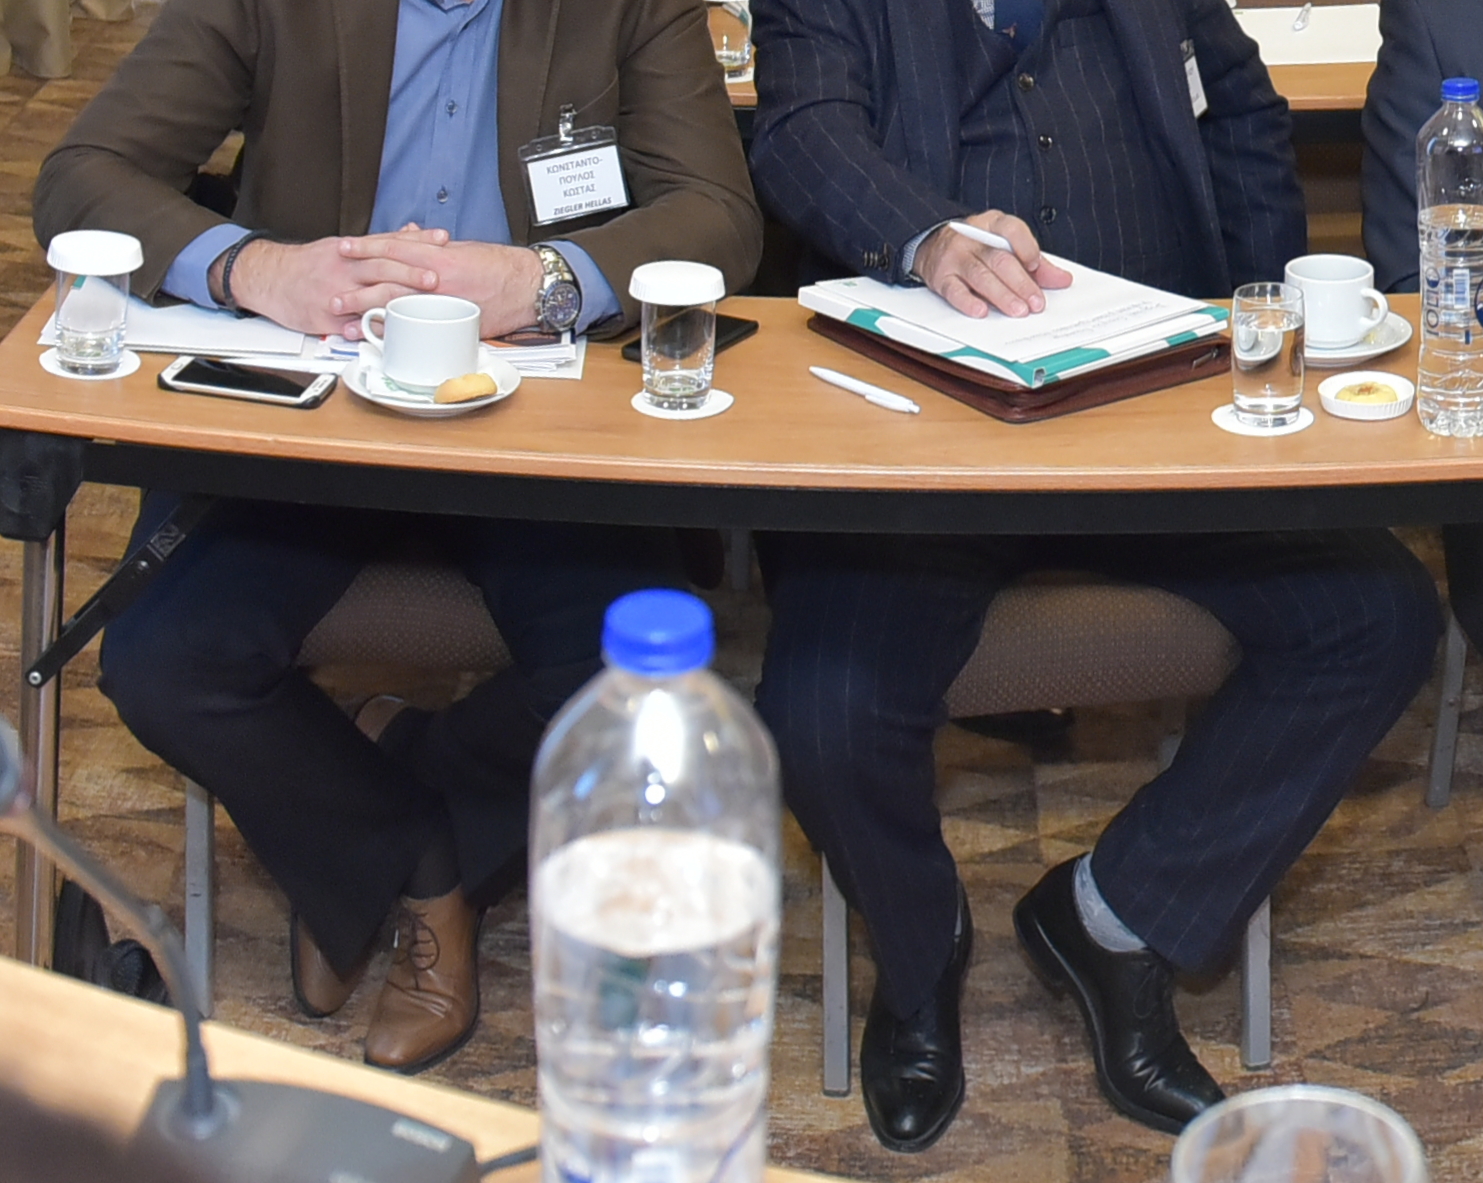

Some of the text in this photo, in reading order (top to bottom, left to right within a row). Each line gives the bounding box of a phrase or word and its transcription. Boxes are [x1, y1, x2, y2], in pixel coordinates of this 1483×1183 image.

[546, 156, 603, 174] ΚΩΝΣΤΑΝΤΟ-
[559, 170, 596, 185] ΠΟΥΛΟΣ
[563, 184, 597, 198] ΚΩΣΤΑΣ
[553, 197, 612, 215] ZIEGLER HELLAS
